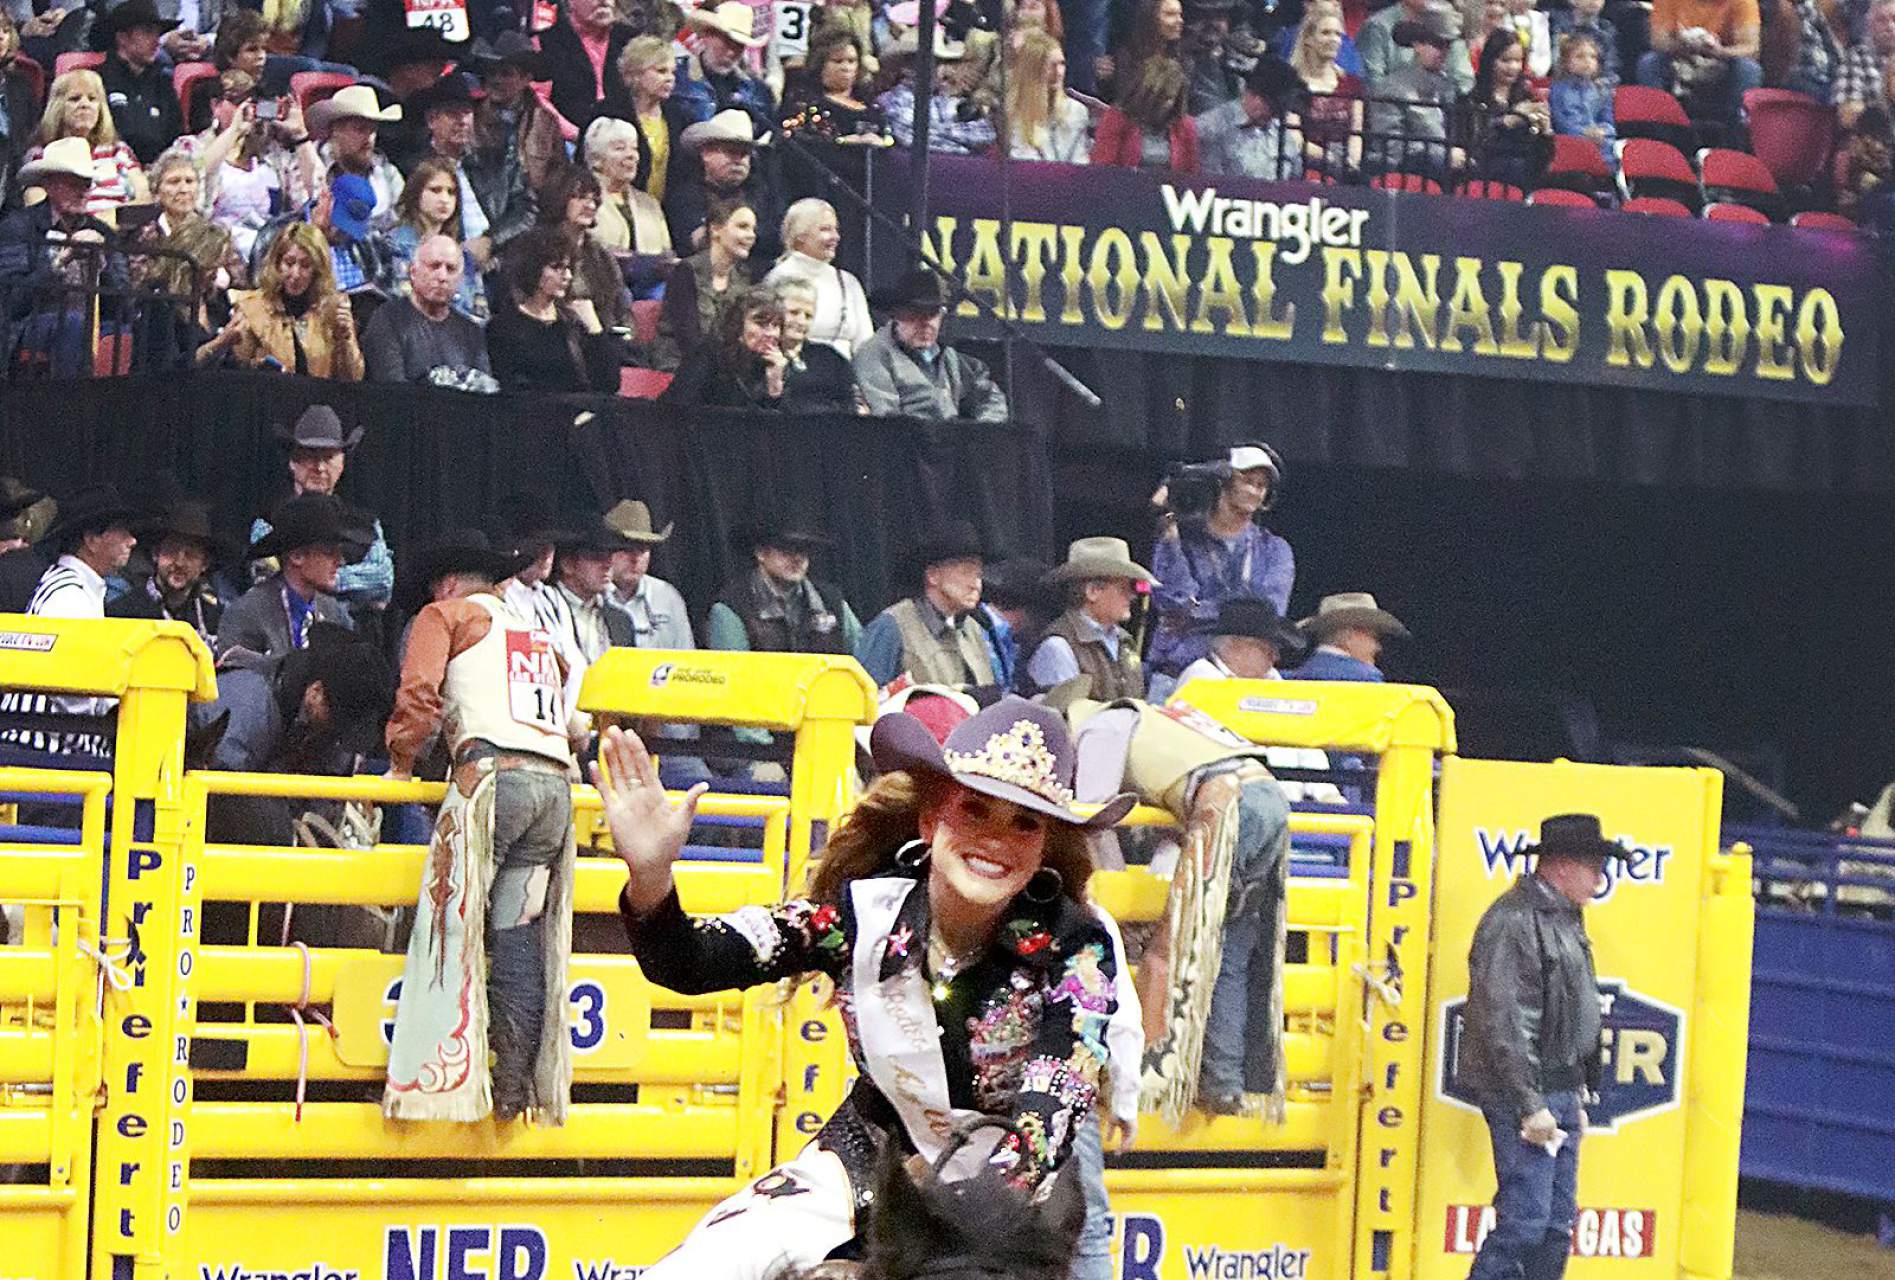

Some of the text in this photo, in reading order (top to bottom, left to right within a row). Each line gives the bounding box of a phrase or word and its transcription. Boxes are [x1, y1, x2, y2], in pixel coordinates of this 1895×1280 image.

[1161, 184, 1369, 264] Wrangler
[1322, 247, 1579, 363] FINALS
[1606, 268, 1844, 385] RODEO
[569, 983, 604, 1048] 3
[1571, 1208, 1644, 1258] GAS
